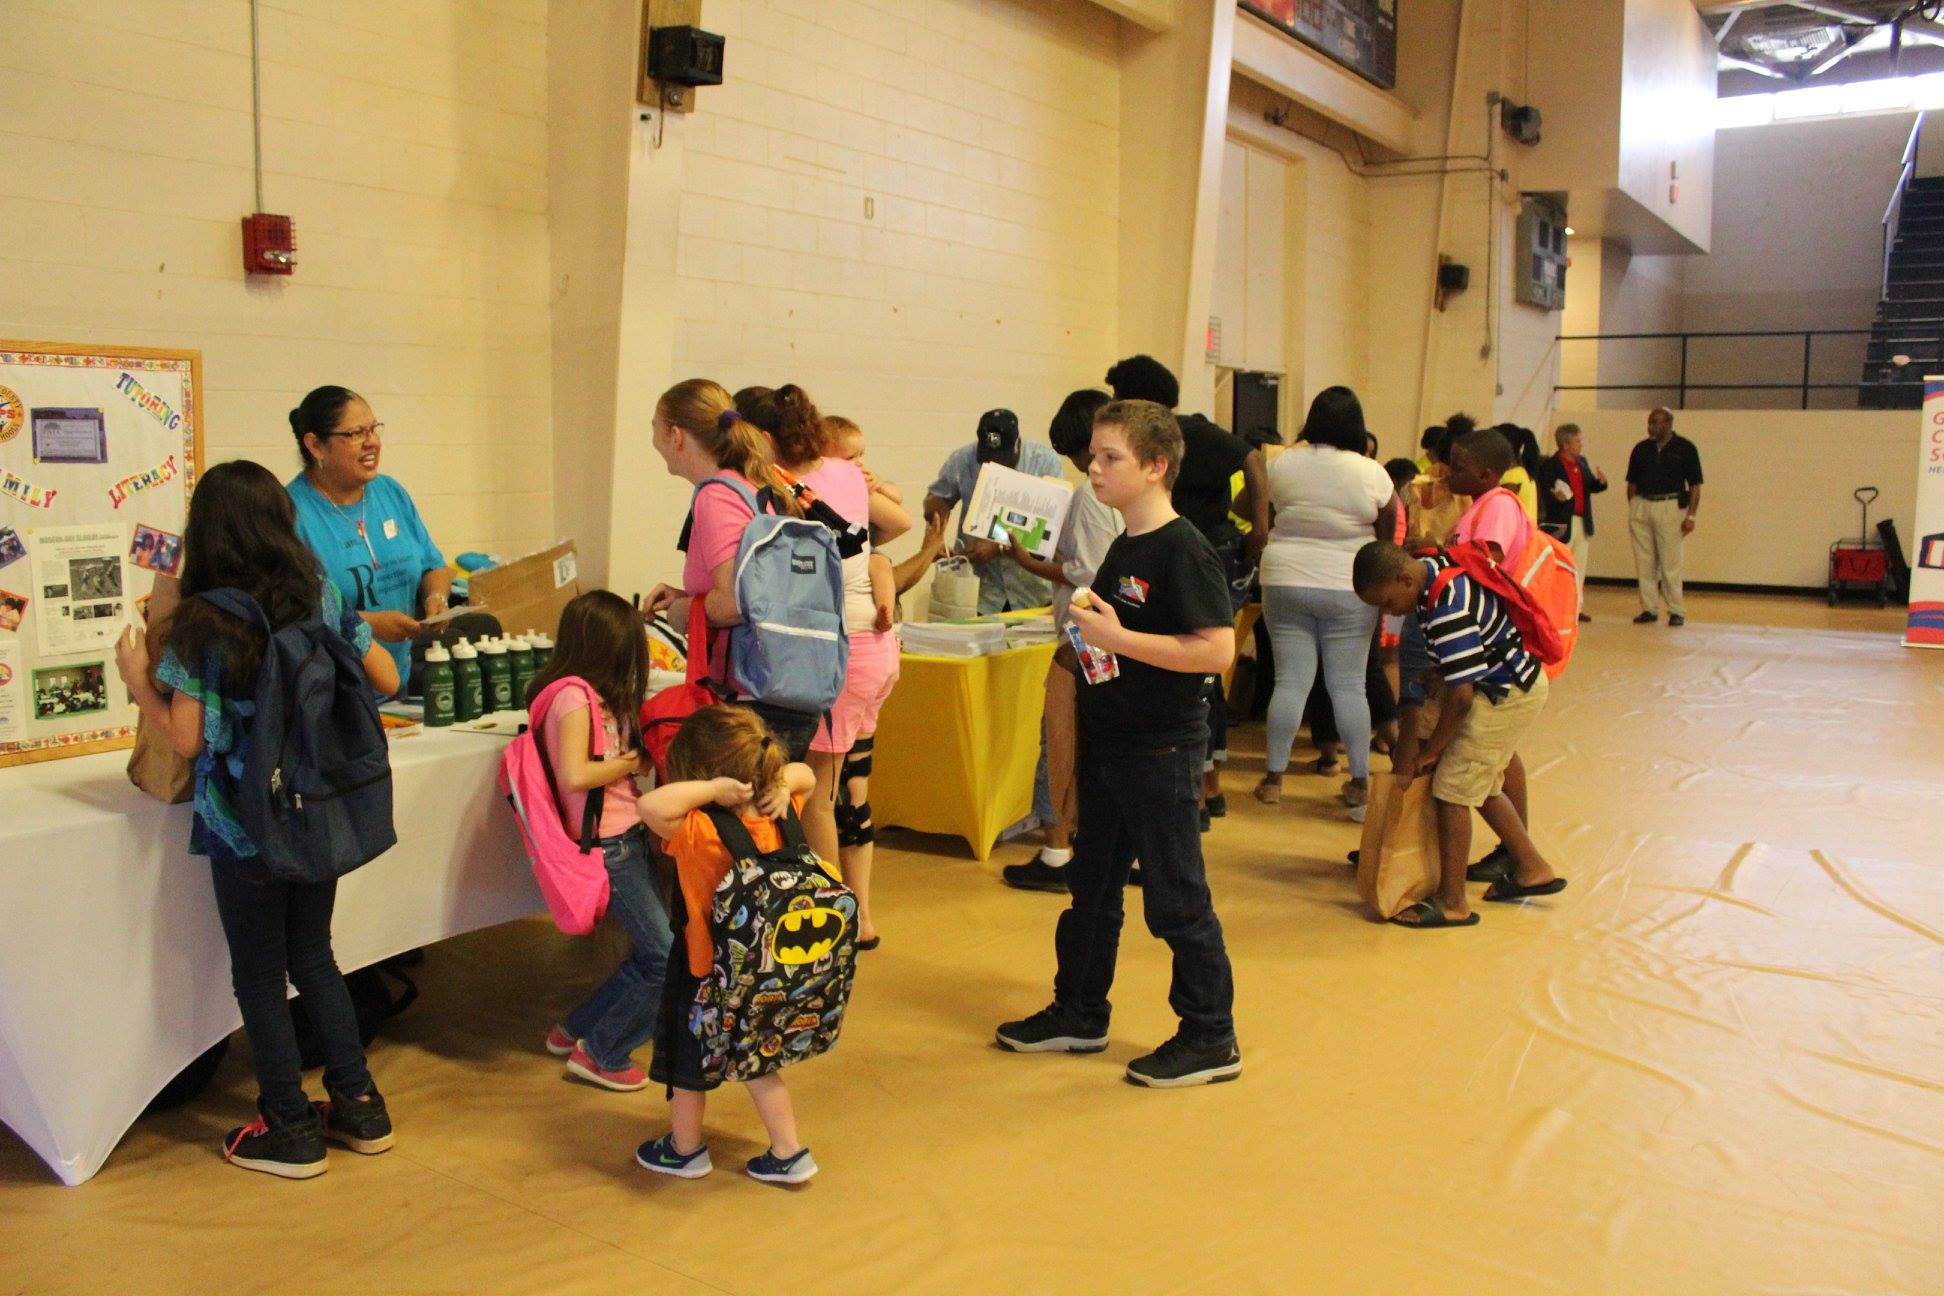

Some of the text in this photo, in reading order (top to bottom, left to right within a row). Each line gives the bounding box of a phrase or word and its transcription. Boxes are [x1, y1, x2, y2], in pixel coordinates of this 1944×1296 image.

[116, 372, 181, 430] TUTORING
[0, 468, 58, 509] MILY
[108, 454, 177, 509] LITERACY
